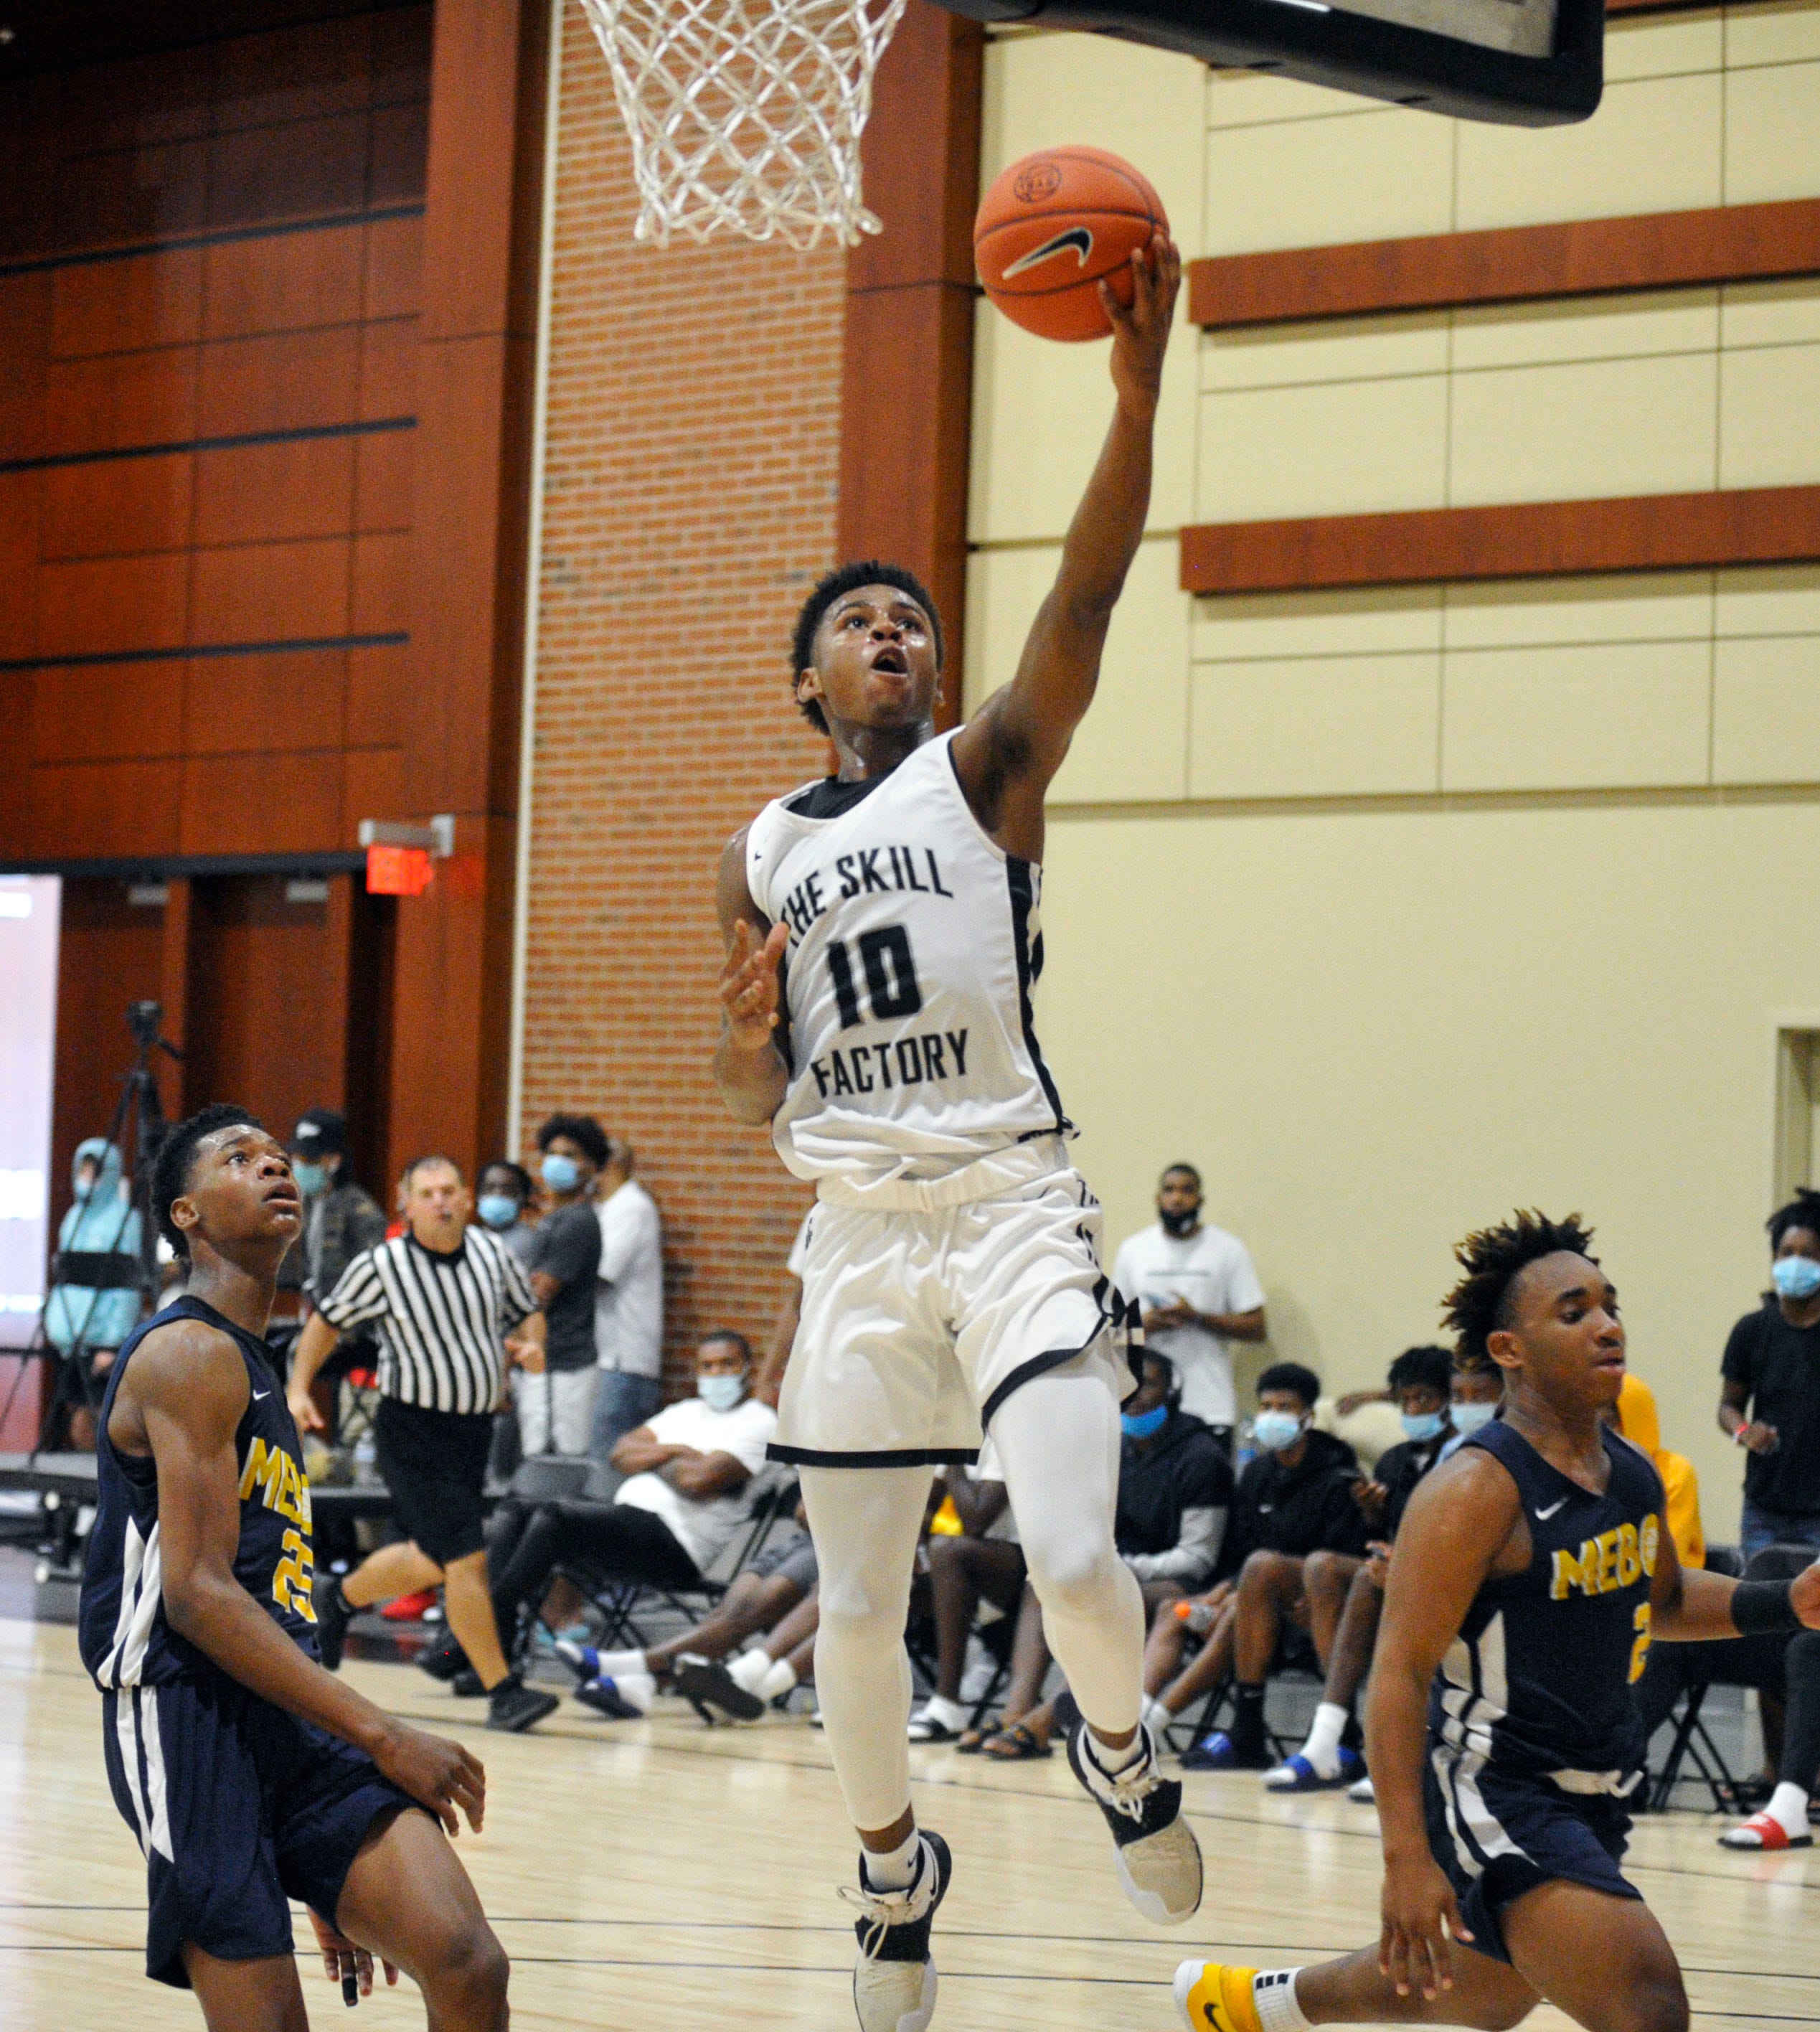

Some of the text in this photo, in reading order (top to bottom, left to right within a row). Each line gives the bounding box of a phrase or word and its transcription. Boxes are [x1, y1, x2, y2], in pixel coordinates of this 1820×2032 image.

[836, 846, 954, 898] SKILL
[826, 923, 923, 1029] 10
[811, 1028, 968, 1099] FACTORY
[1550, 1513, 1659, 1601] MEBO
